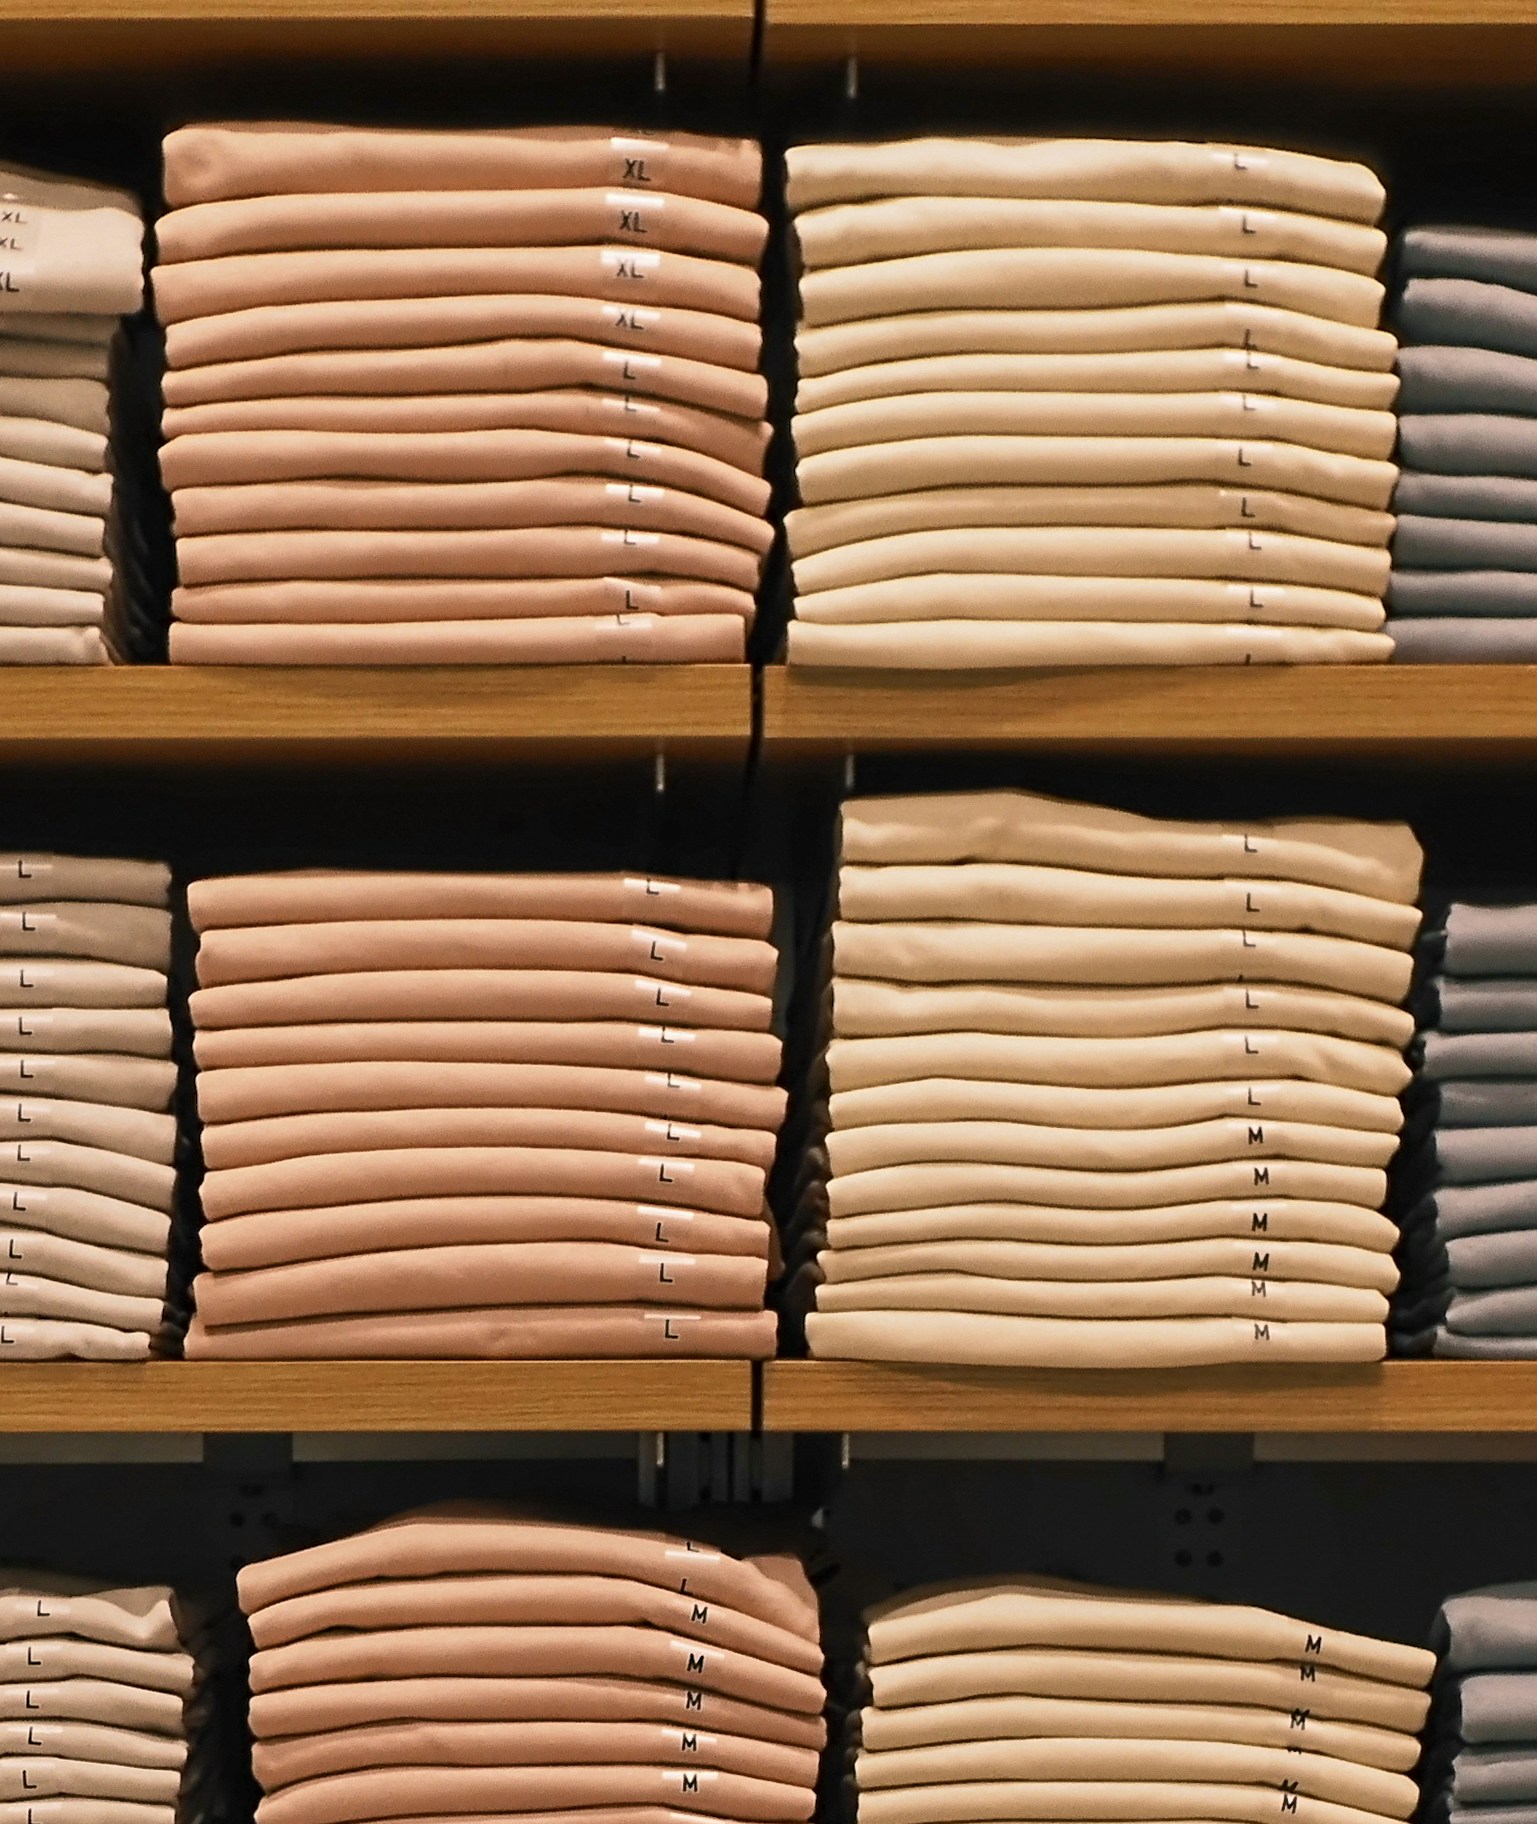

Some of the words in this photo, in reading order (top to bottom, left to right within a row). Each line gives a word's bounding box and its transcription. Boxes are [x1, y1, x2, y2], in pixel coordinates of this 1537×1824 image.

[623, 158, 650, 181] XL
[2, 212, 27, 223] XL
[619, 210, 647, 232] XL
[1243, 215, 1256, 234] L
[1245, 270, 1258, 288] L
[624, 362, 635, 379] L
[1238, 448, 1251, 466] L
[1241, 497, 1255, 517] L
[1248, 531, 1261, 550] L
[626, 590, 638, 609] L
[1250, 589, 1263, 608] L
[1247, 893, 1260, 912] L
[23, 912, 35, 930] L
[651, 941, 663, 960] L
[1246, 989, 1259, 1008] L
[19, 1017, 32, 1035] L
[21, 1060, 33, 1078] L
[1248, 1127, 1263, 1144] M
[659, 1164, 673, 1182] L
[13, 1192, 26, 1211] L
[1252, 1213, 1267, 1231] M
[656, 1222, 668, 1242] L
[9, 1239, 22, 1258] L
[1253, 1252, 1269, 1271] M
[660, 1263, 673, 1282] L
[1, 1326, 14, 1343] L
[665, 1319, 678, 1338] L
[1254, 1324, 1270, 1340] M
[691, 1604, 707, 1624] M
[1305, 1635, 1322, 1654] M
[28, 1647, 41, 1665] L
[687, 1653, 704, 1673] M
[681, 1733, 697, 1751] M
[23, 1770, 37, 1789] L
[683, 1774, 697, 1792] M
[1281, 1794, 1297, 1813] M
